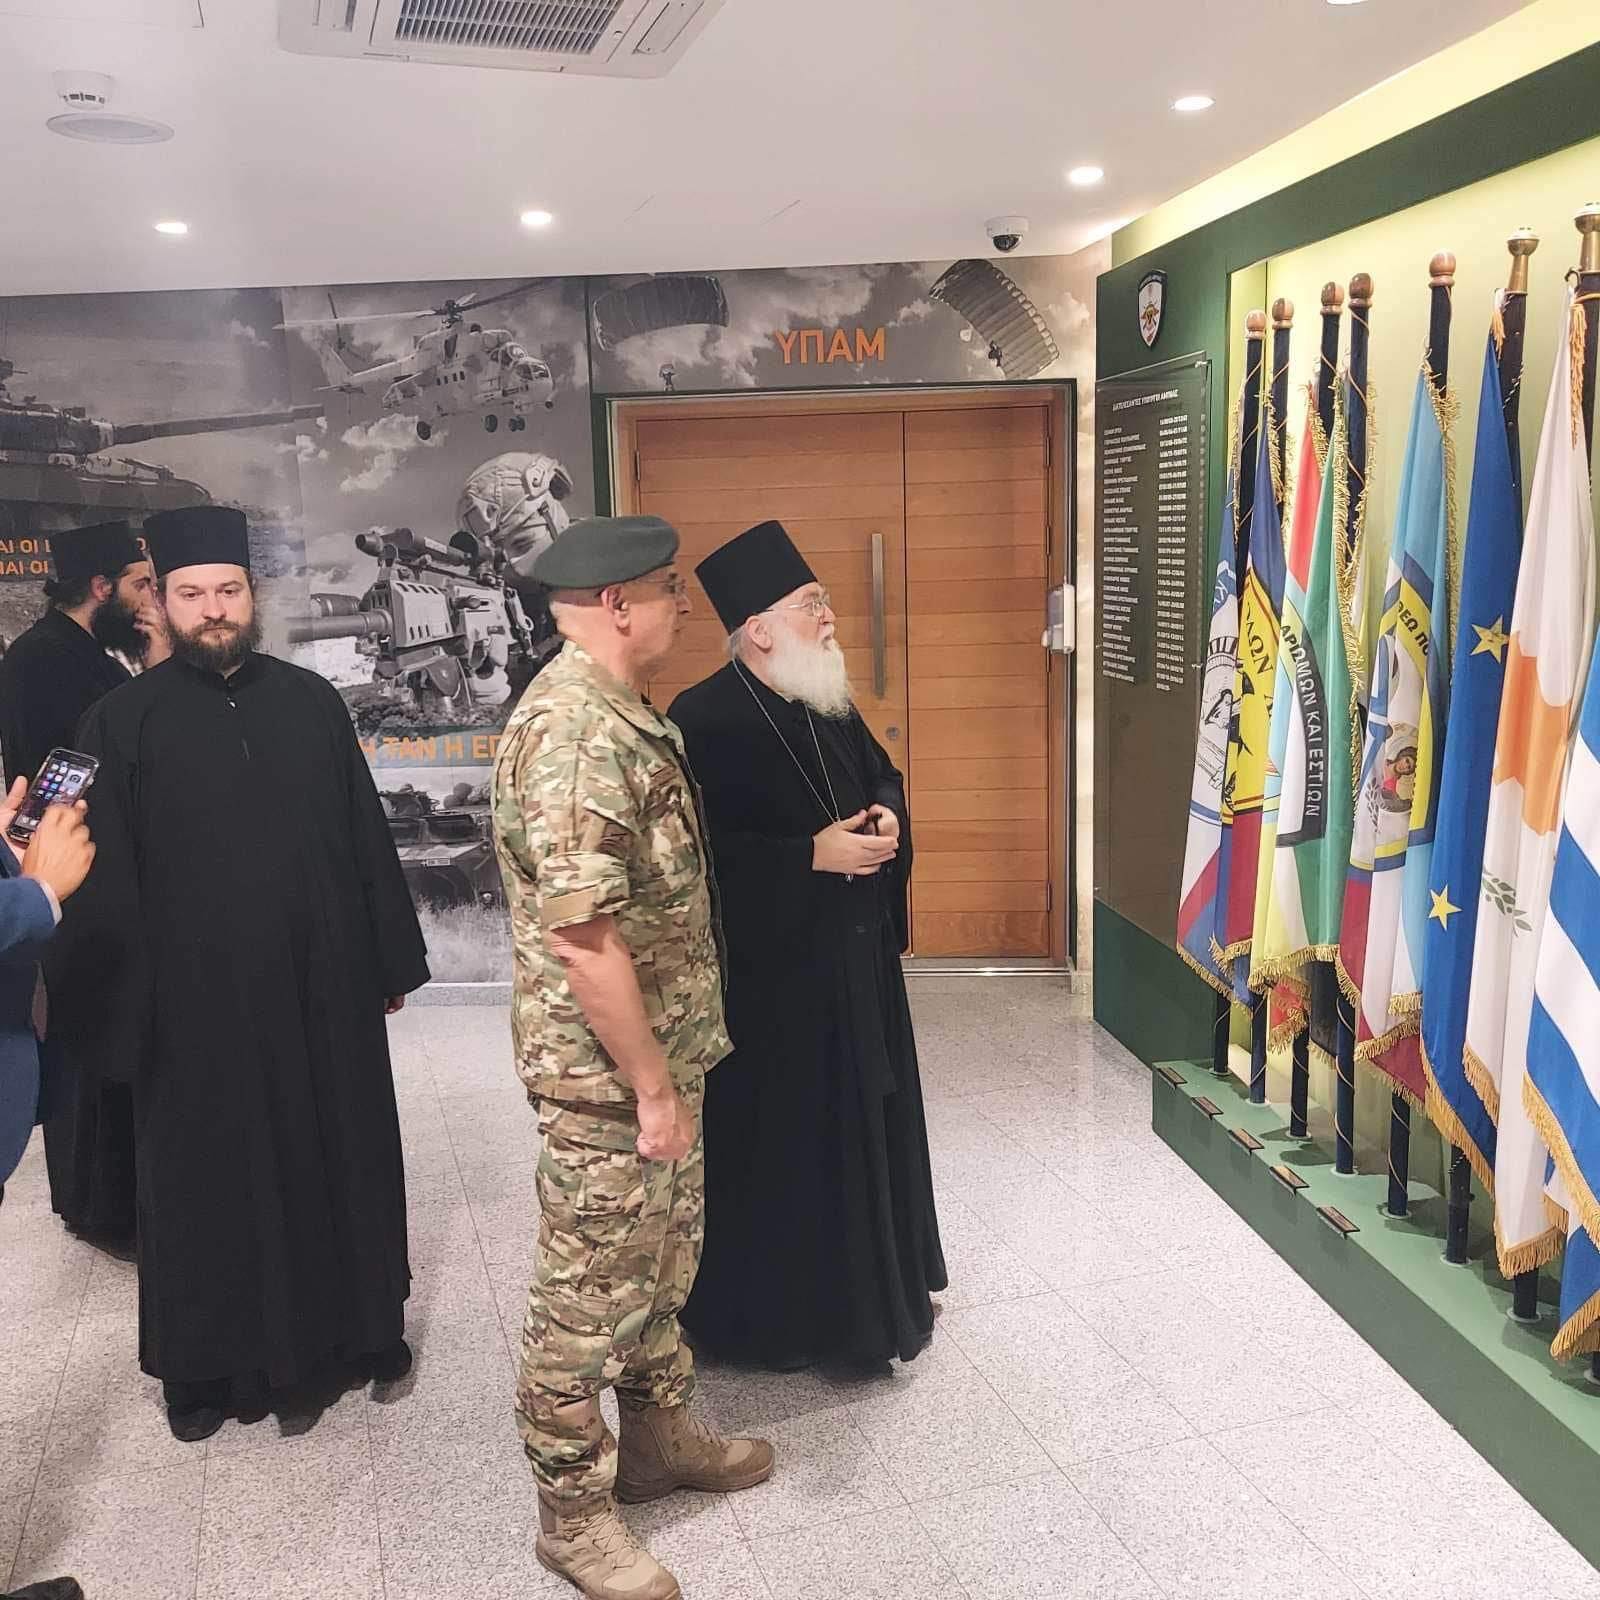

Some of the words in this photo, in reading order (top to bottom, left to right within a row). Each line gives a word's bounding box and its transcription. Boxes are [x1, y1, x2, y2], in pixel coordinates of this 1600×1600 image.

[774, 327, 885, 364] ΥΠΑΜ
[1307, 710, 1322, 742] ΚΑΙ
[1305, 748, 1324, 816] ΕΣΤΙΩΝ
